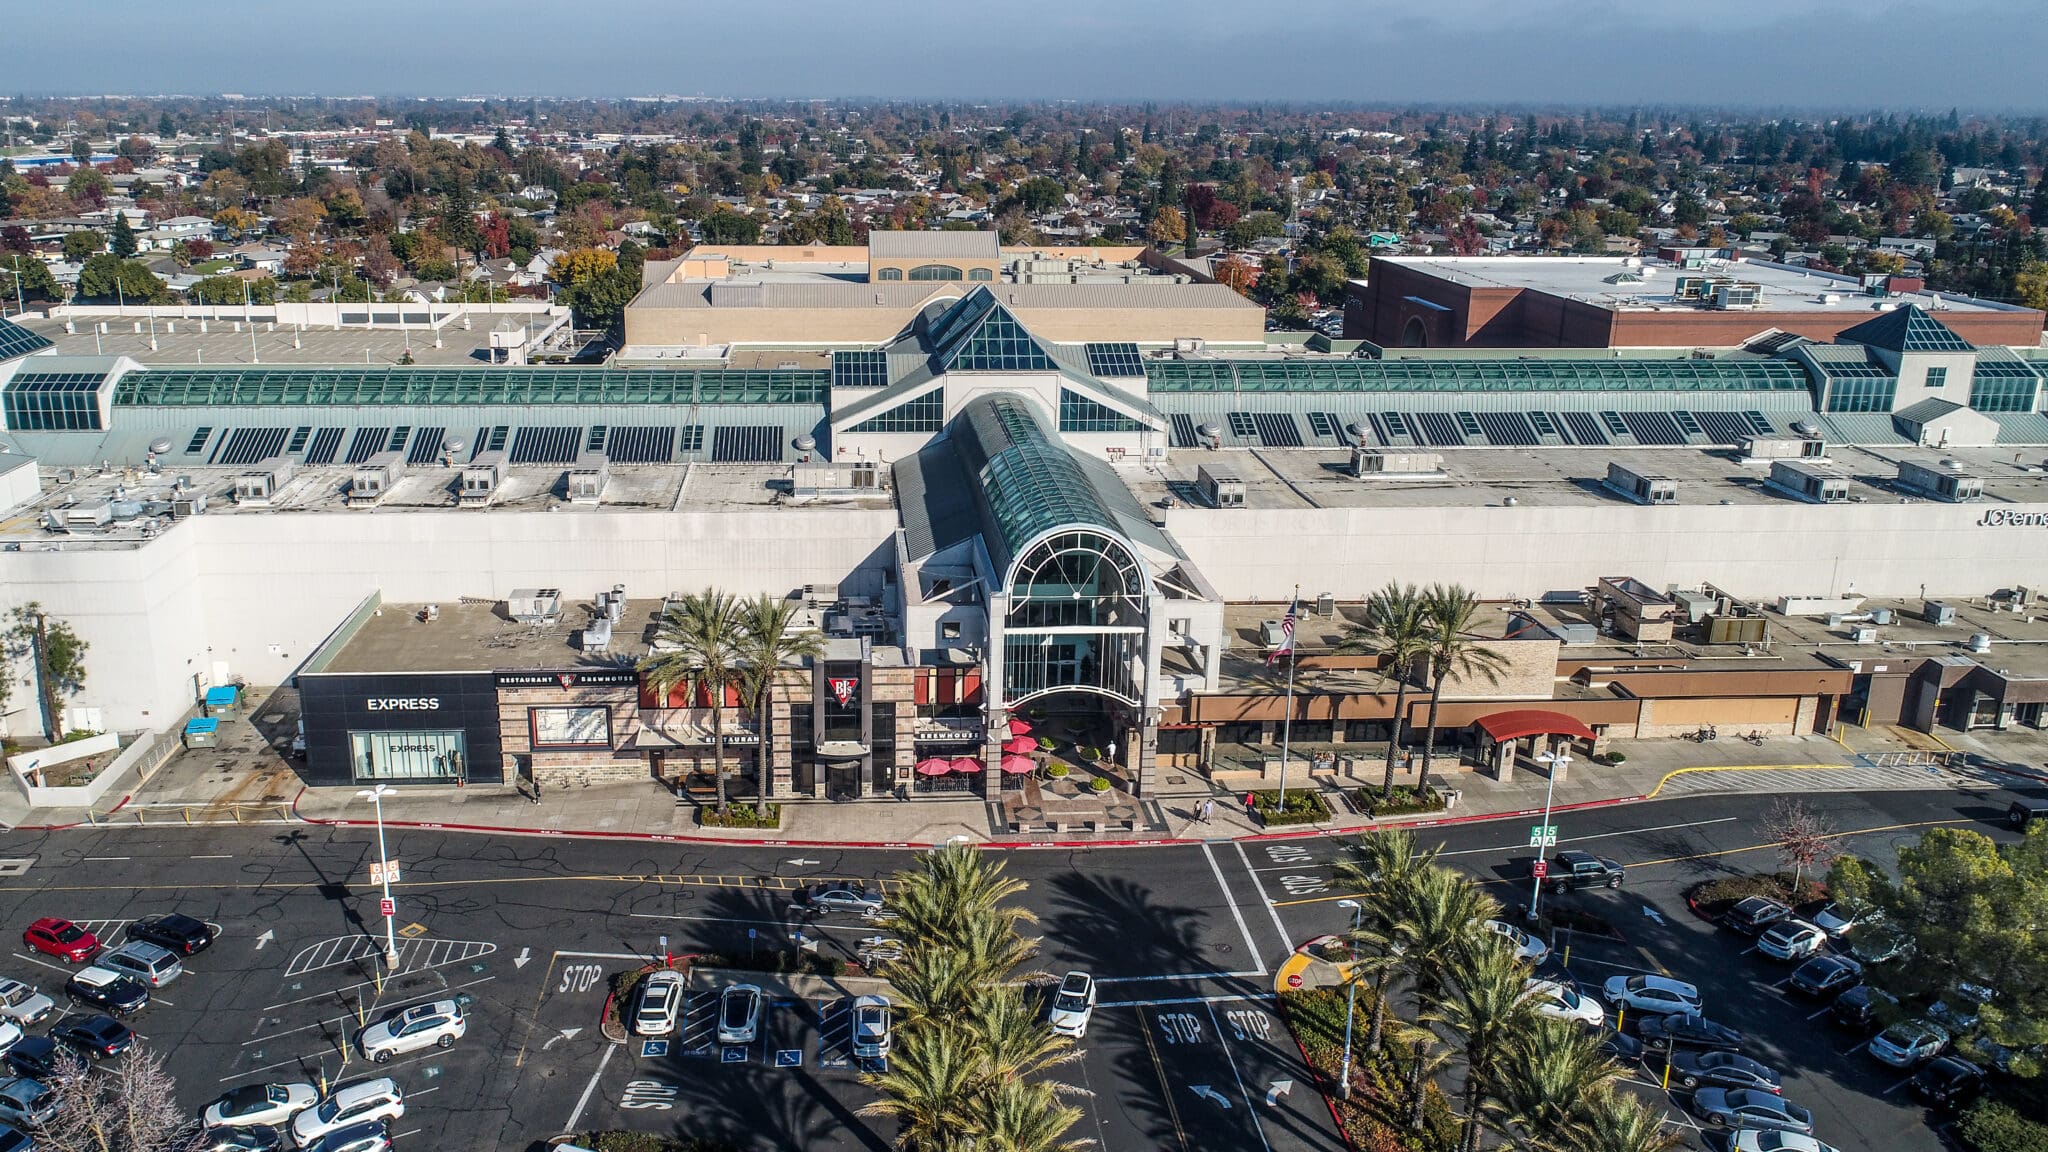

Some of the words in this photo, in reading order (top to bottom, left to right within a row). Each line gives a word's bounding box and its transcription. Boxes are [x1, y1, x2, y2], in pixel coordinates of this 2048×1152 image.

[500, 676, 553, 684] RESTAURANT
[580, 675, 634, 683] BREWHOUSE
[835, 680, 852, 699] BJ's
[367, 698, 440, 711] EXPRESS
[920, 732, 979, 740] BREWHOUSE
[390, 744, 436, 753] EXPRESS
[1534, 827, 1541, 836] 5
[1548, 827, 1556, 836] 5
[1532, 837, 1540, 846] A
[1546, 837, 1554, 845] A
[372, 864, 381, 874] 6
[373, 875, 382, 884] A
[389, 872, 399, 881] A
[558, 964, 602, 993] STOP
[1288, 977, 1302, 985] STOP
[1158, 1013, 1201, 1044] STOP
[1226, 1010, 1271, 1041] STOP
[619, 1080, 679, 1110] STOP
